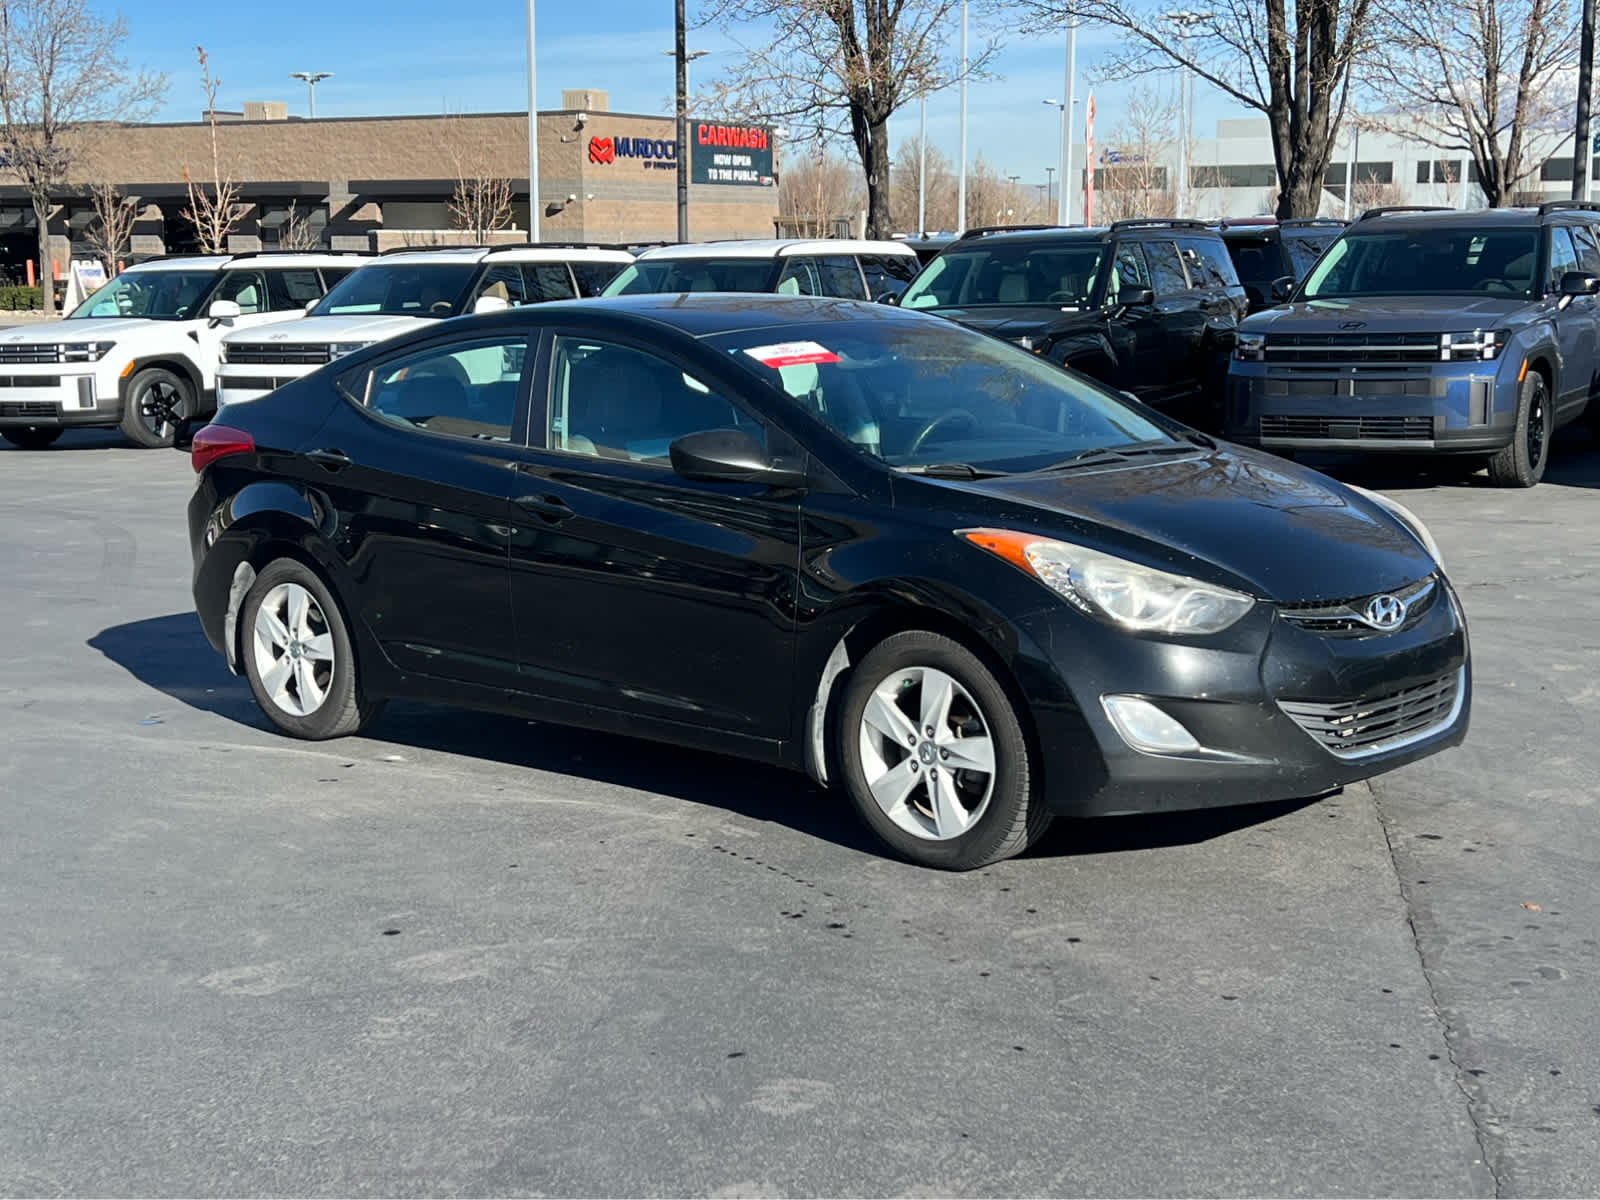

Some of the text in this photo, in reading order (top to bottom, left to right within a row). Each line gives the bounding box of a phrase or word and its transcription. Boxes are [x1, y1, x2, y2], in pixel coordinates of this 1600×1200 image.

[698, 124, 768, 150] CARWASH
[713, 154, 752, 166] NOW OPEN
[708, 168, 718, 180] TO
[718, 169, 733, 181] THE
[733, 170, 759, 181] PUBLIC
